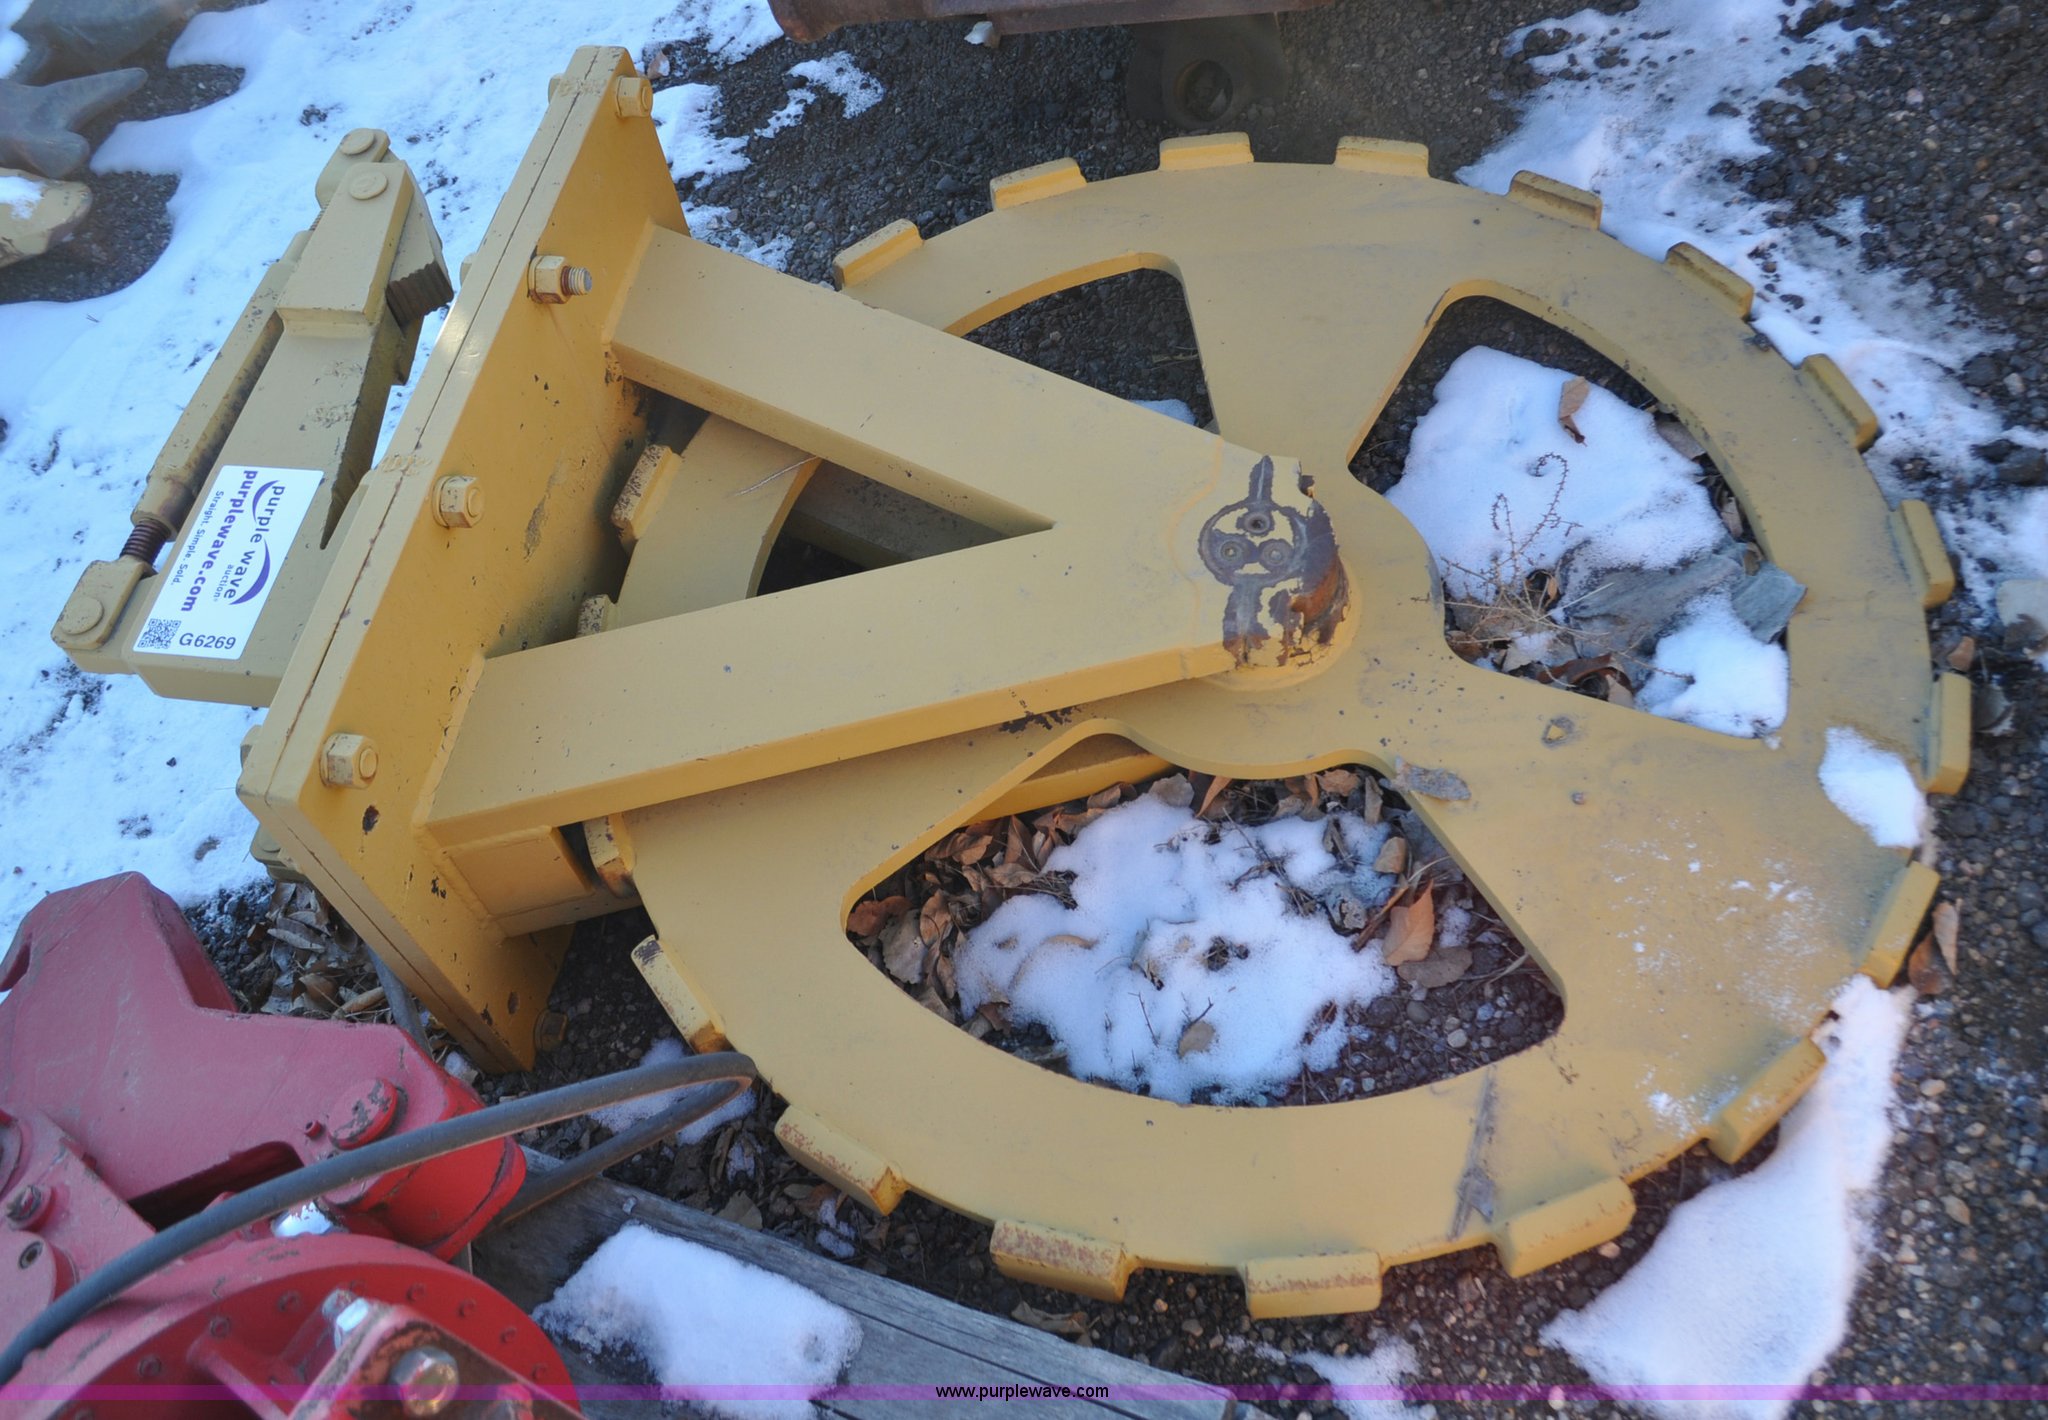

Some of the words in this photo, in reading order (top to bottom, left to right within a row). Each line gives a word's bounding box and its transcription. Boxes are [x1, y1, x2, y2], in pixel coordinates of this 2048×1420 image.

[203, 490, 224, 526] Straight.
[250, 486, 285, 543] purple
[181, 470, 258, 612] purplewave.com
[185, 529, 206, 561] Simple.
[171, 563, 188, 586] Sold.
[223, 550, 255, 599] wave
[179, 632, 236, 650] G6269
